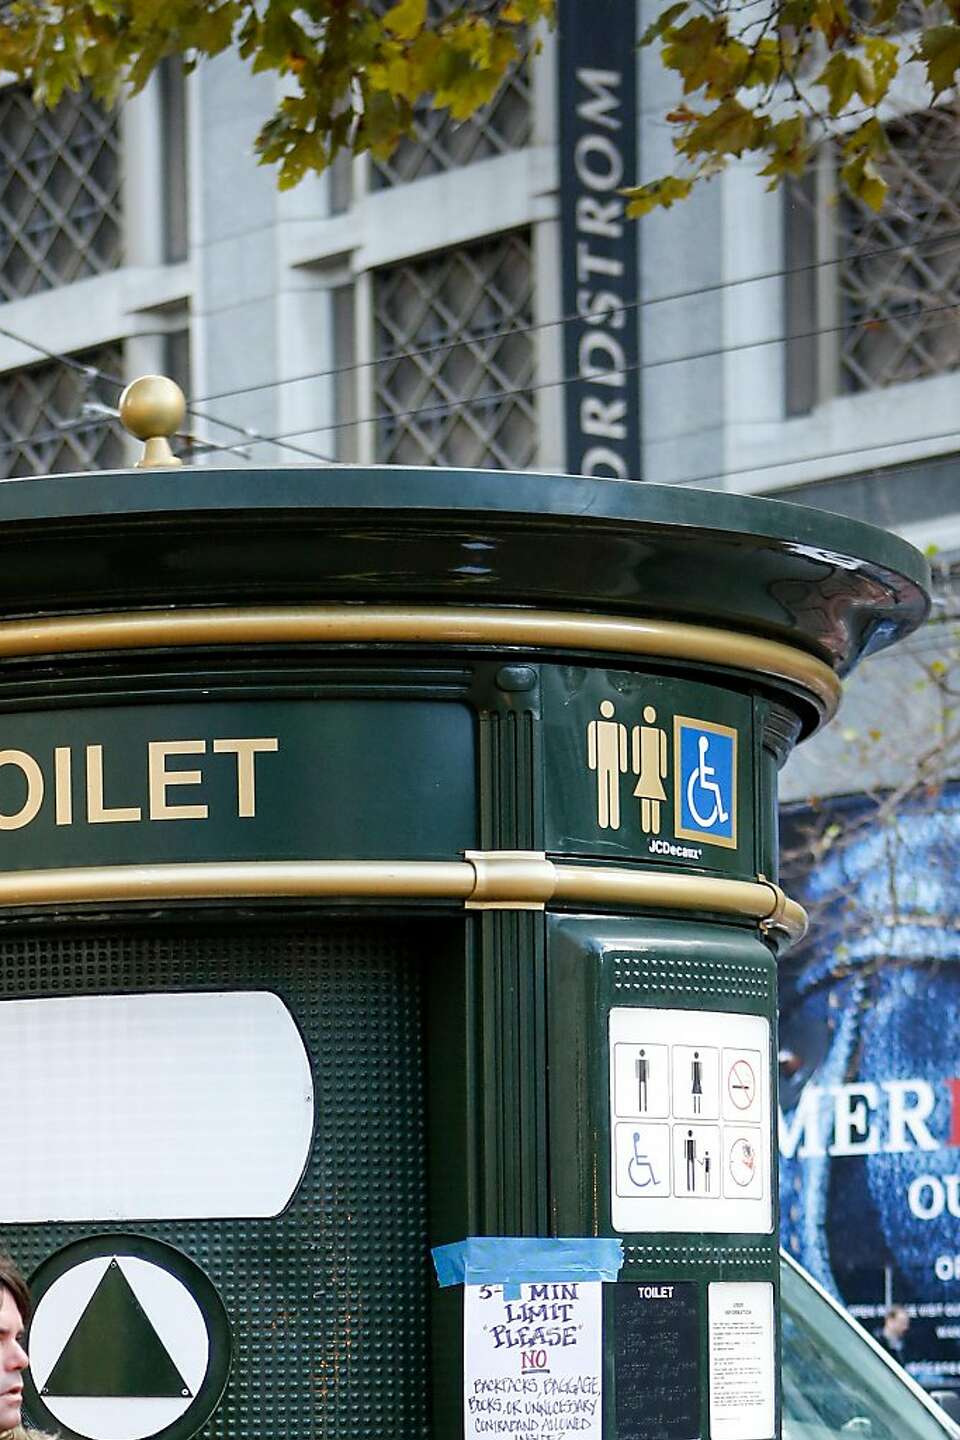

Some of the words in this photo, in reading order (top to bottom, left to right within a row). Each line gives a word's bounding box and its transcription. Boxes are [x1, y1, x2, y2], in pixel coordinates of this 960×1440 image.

[528, 1283, 579, 1302] MIN
[638, 1286, 674, 1299] TOILET
[504, 1303, 574, 1323] LIMIT
[521, 1349, 547, 1369] NO
